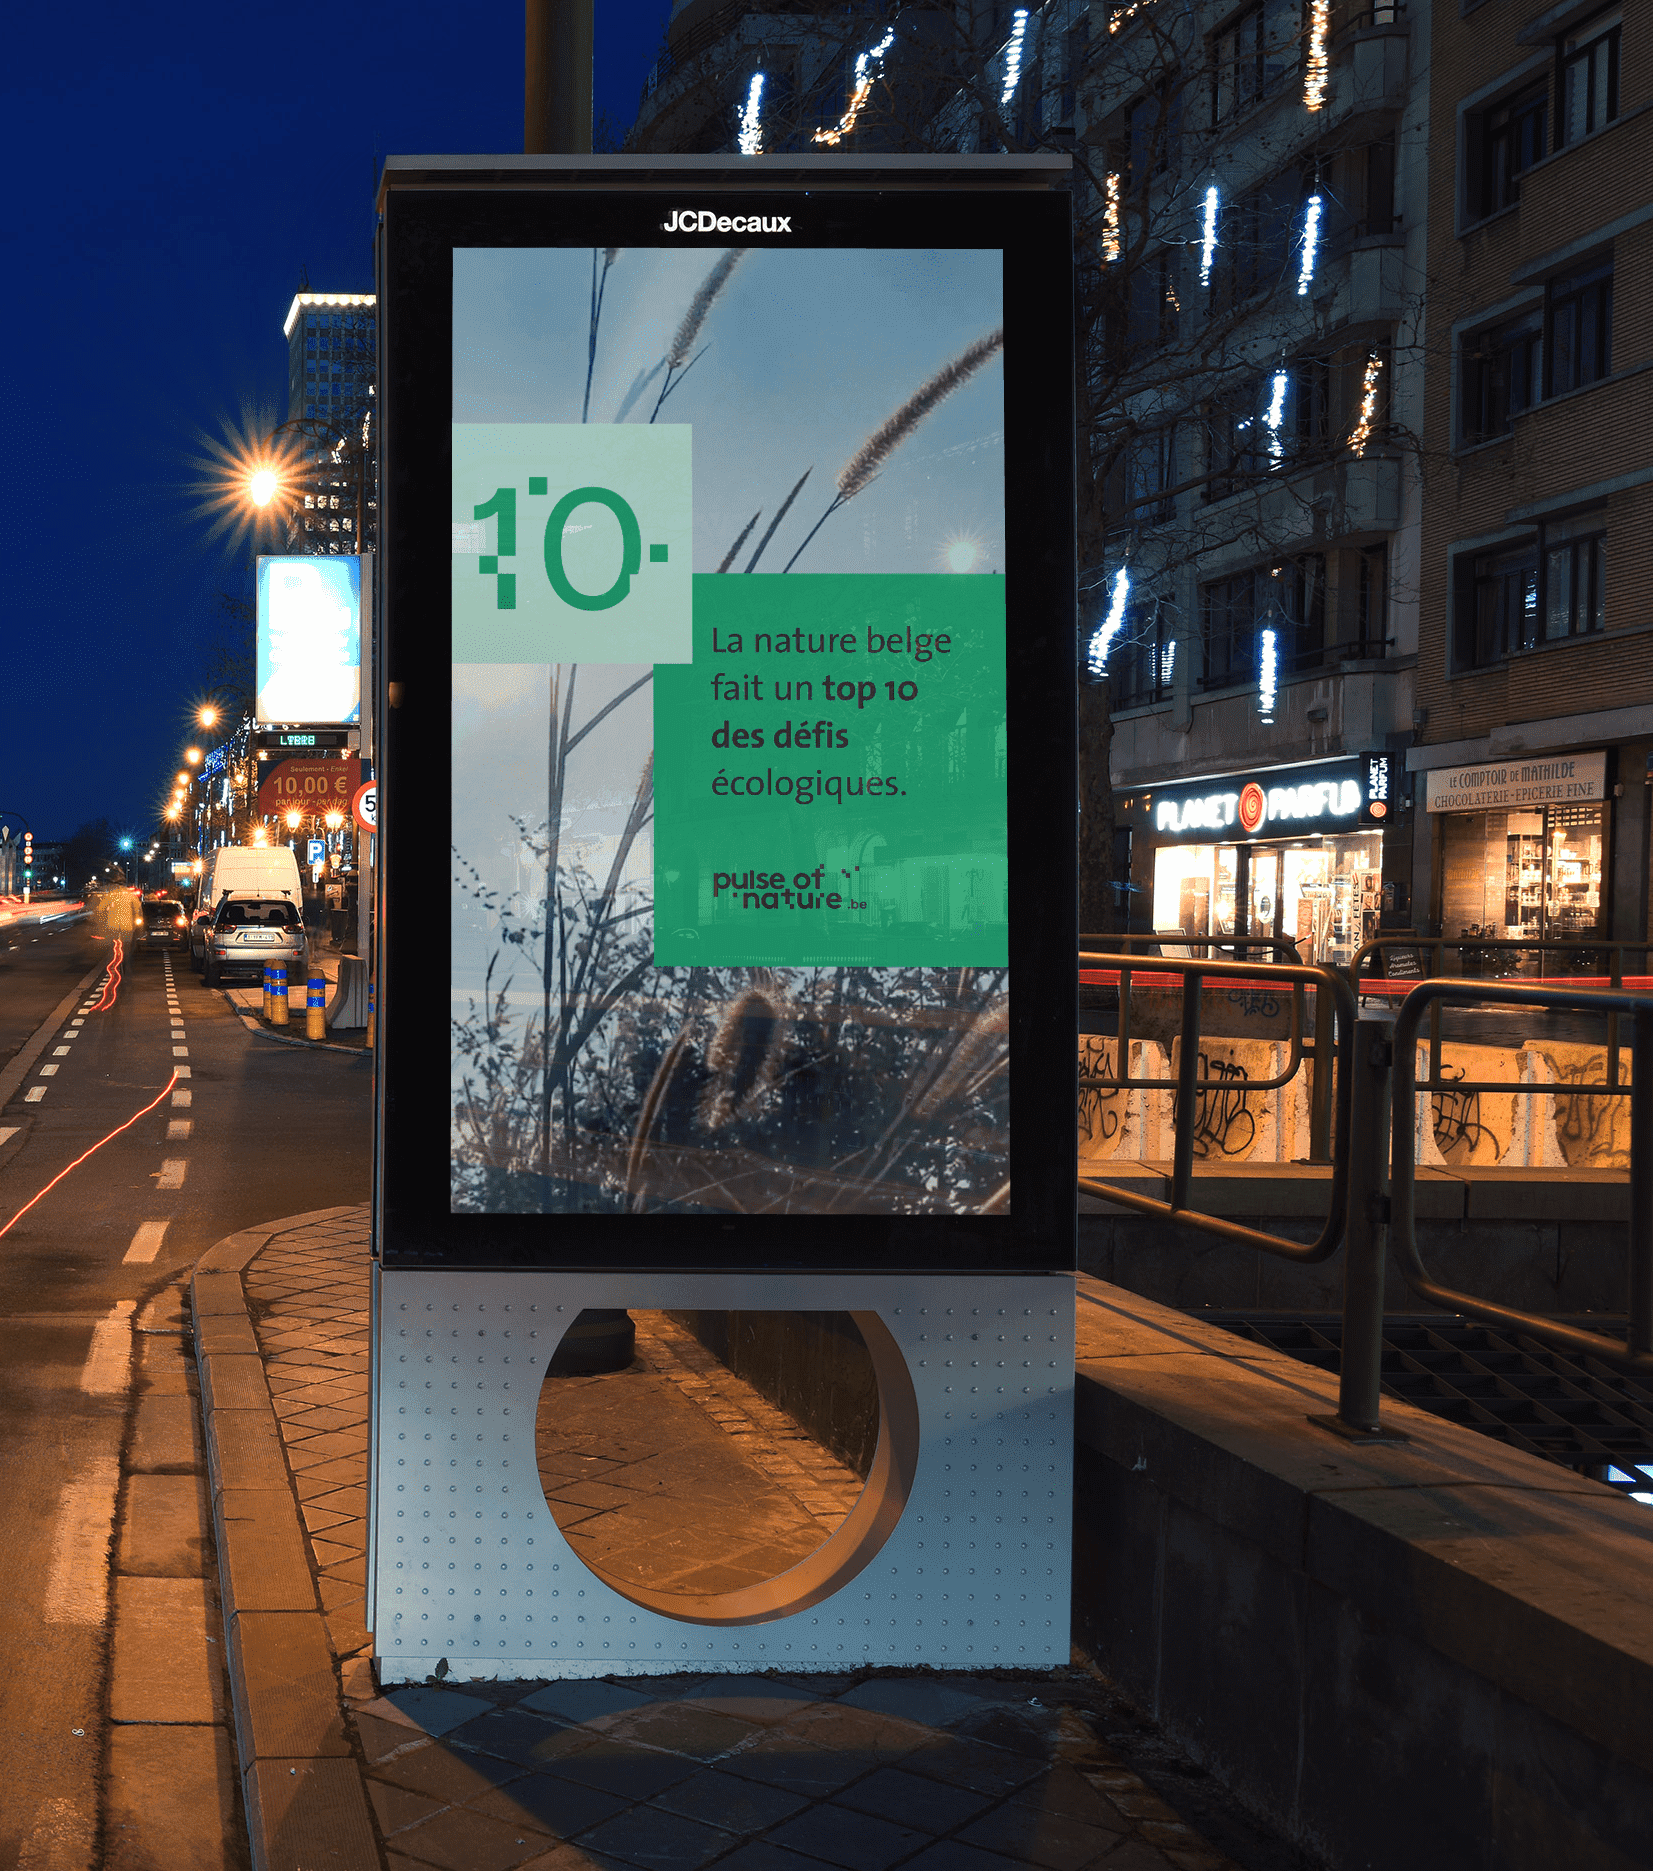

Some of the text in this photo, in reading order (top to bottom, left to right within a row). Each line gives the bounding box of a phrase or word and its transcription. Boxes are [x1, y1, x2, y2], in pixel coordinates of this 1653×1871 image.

[664, 210, 792, 234] JCDecaux
[473, 484, 643, 612] 10
[712, 626, 953, 664] La nature belge
[711, 673, 920, 709] fait un top 10
[712, 720, 850, 750] des défis
[273, 776, 348, 797] 10,00 €
[712, 768, 908, 805] écologiques.
[1369, 758, 1379, 799] PLANET
[1378, 757, 1388, 799] PARFUM
[1449, 761, 1575, 788] LE COMPTOIR DE MATHILDE
[1566, 782, 1595, 797] FINE
[1157, 793, 1240, 832] PLANET
[309, 843, 323, 861] P
[713, 869, 786, 898] pulse
[742, 884, 843, 910] nature
